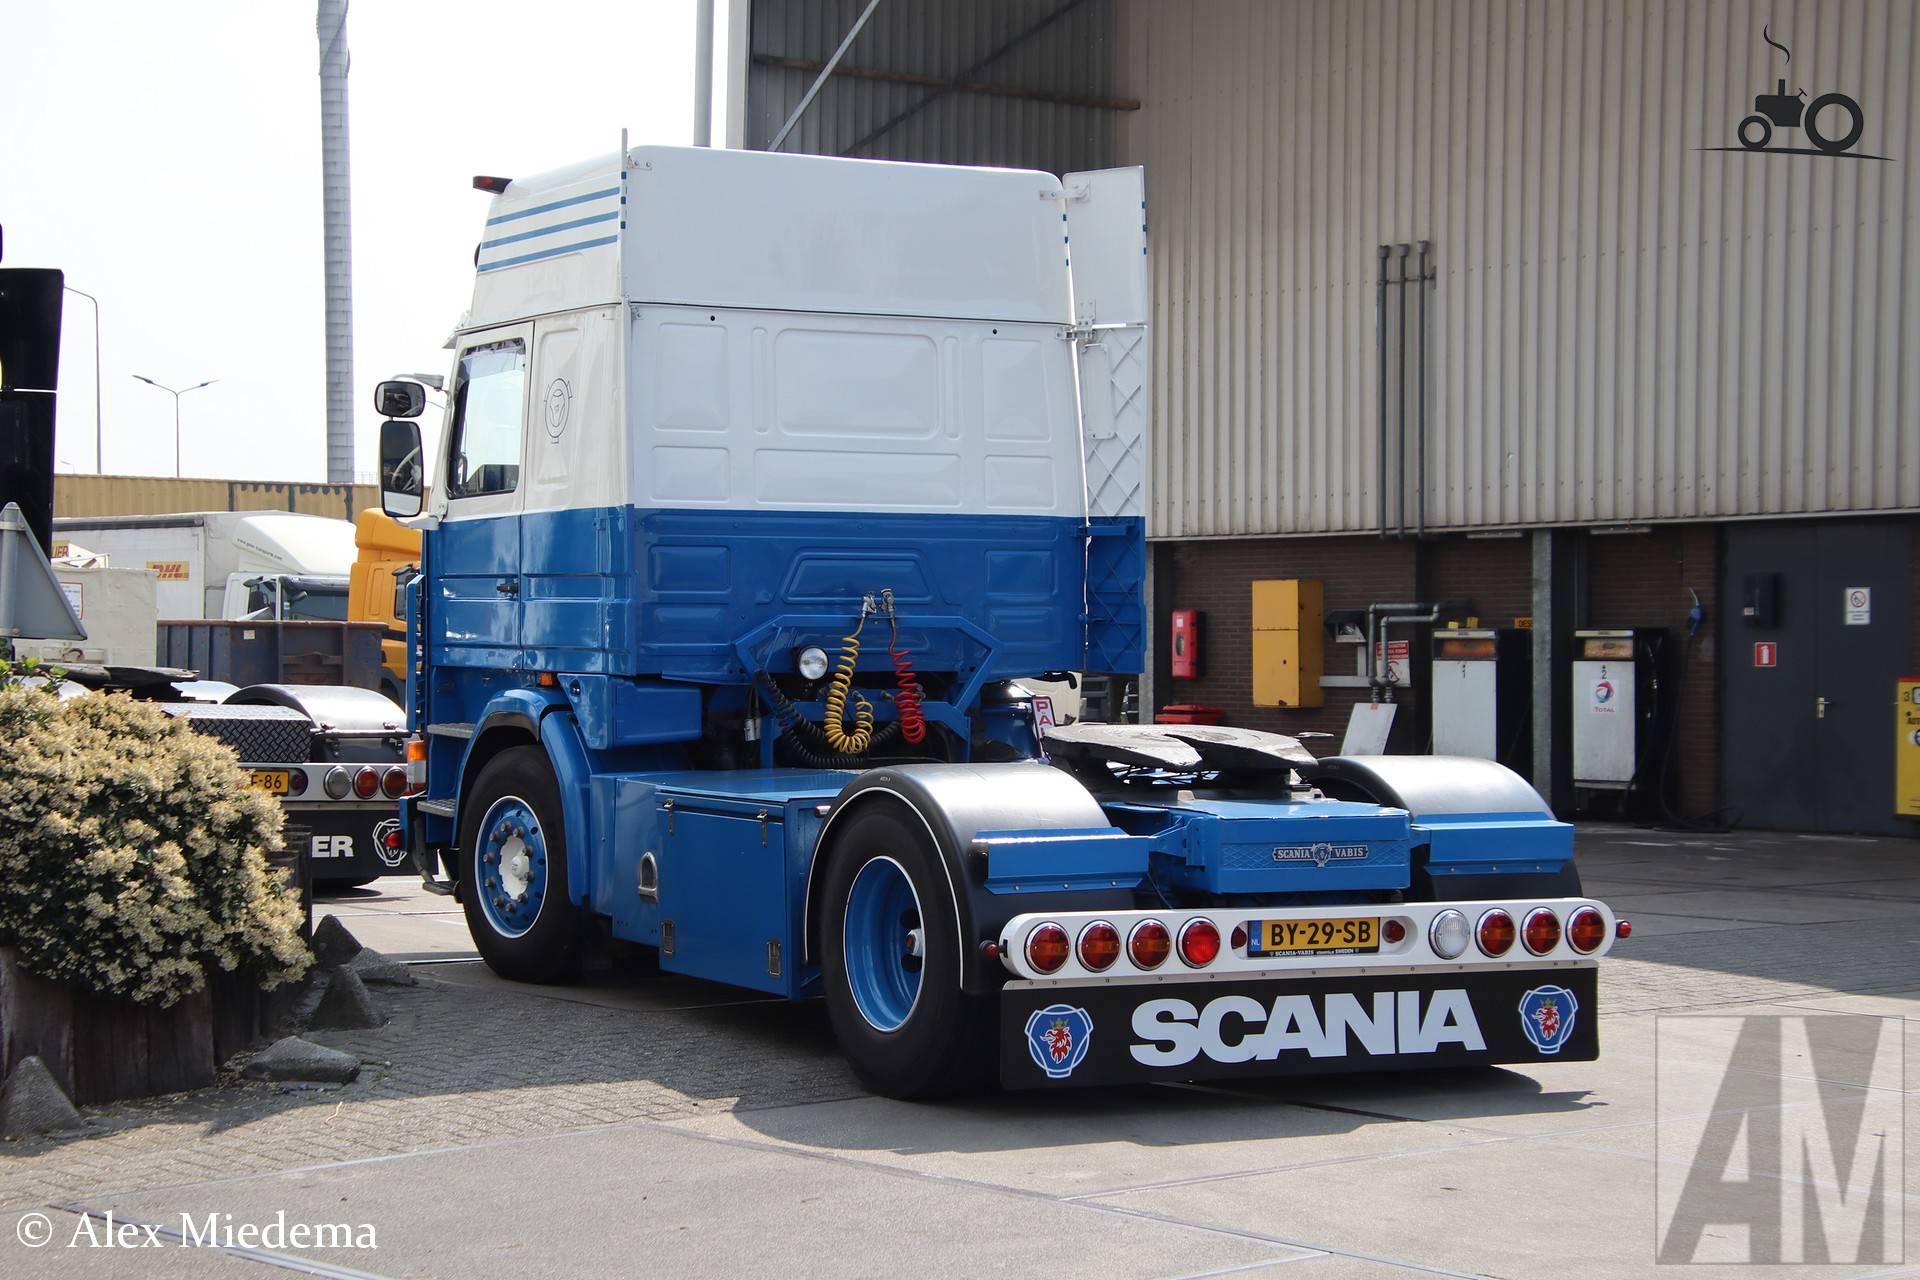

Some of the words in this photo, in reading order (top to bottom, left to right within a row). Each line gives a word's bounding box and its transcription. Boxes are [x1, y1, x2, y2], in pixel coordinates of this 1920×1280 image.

[1601, 669, 1608, 680] 2
[1277, 849, 1311, 859] SCANIA
[1335, 847, 1364, 858] VABIS
[1271, 920, 1371, 946] BY-29-SB
[1130, 989, 1488, 1067] SCANIA
